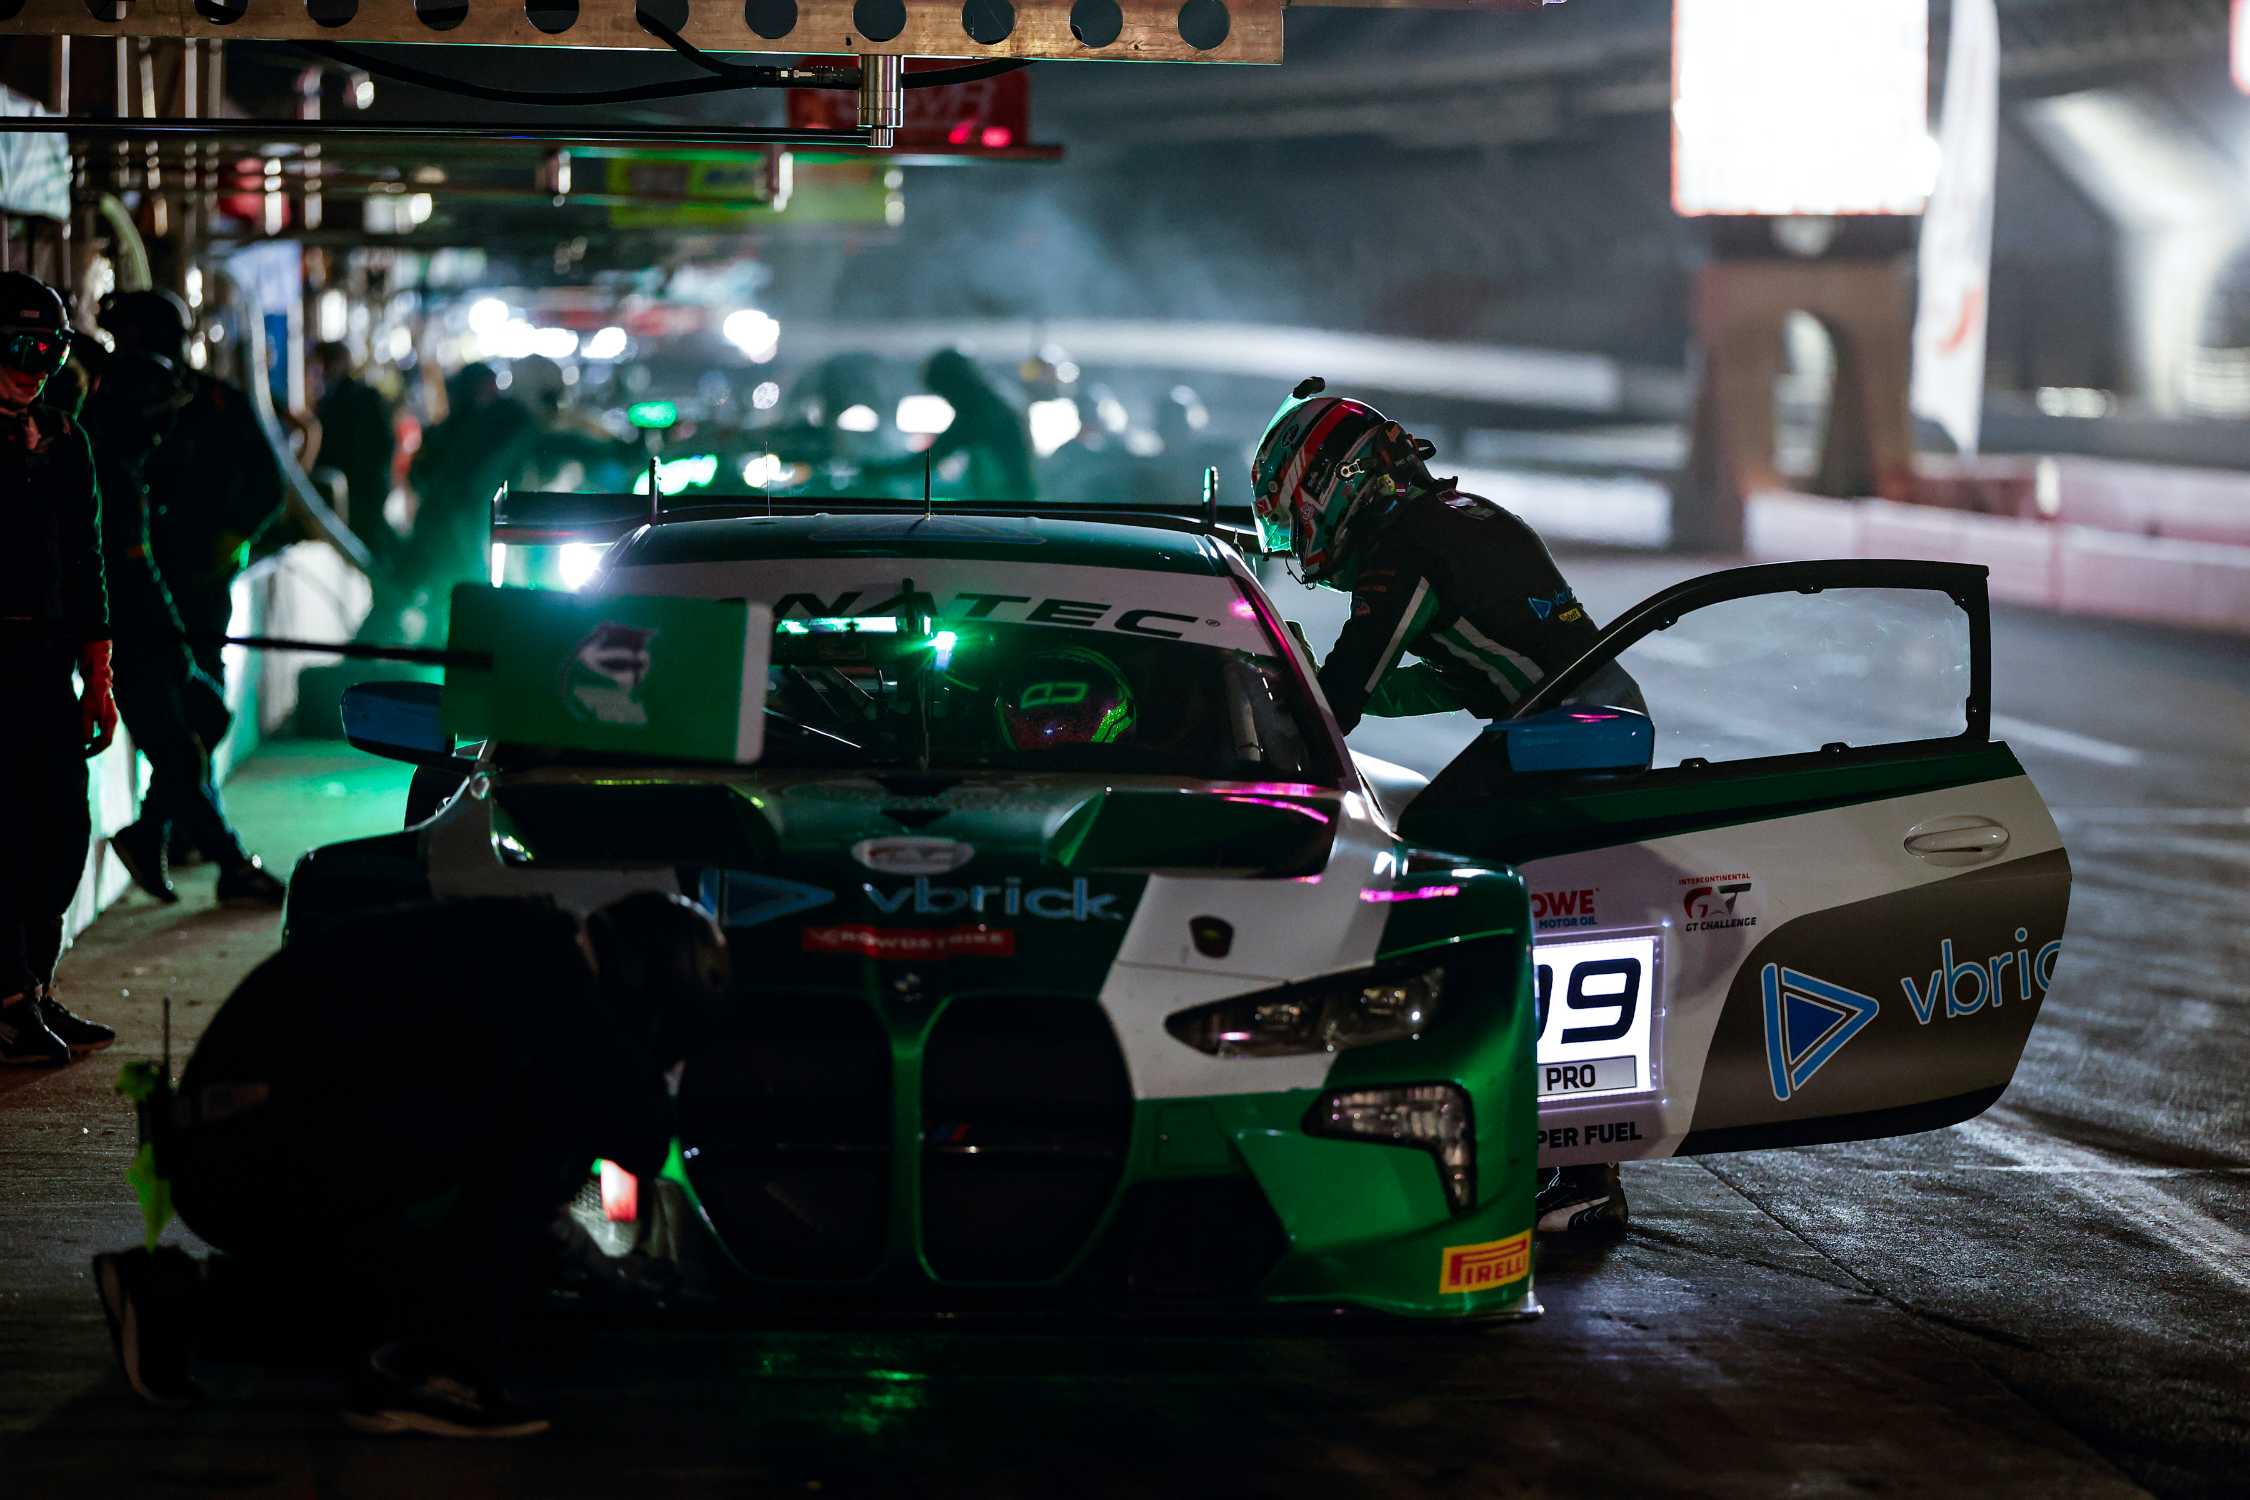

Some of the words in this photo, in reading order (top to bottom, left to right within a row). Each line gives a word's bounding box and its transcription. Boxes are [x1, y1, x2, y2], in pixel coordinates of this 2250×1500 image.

[1679, 872, 1750, 885] INTERCONTINENTAL
[863, 876, 1123, 921] vbrick
[1539, 917, 1578, 928] MOTOR
[1580, 916, 1598, 926] OIL
[1686, 922, 1699, 932] GT
[1700, 916, 1757, 930] CHALLENGE
[1546, 1064, 1596, 1091] PRO
[1584, 1121, 1642, 1145] FUEL
[1448, 1238, 1527, 1286] PIRELLI
